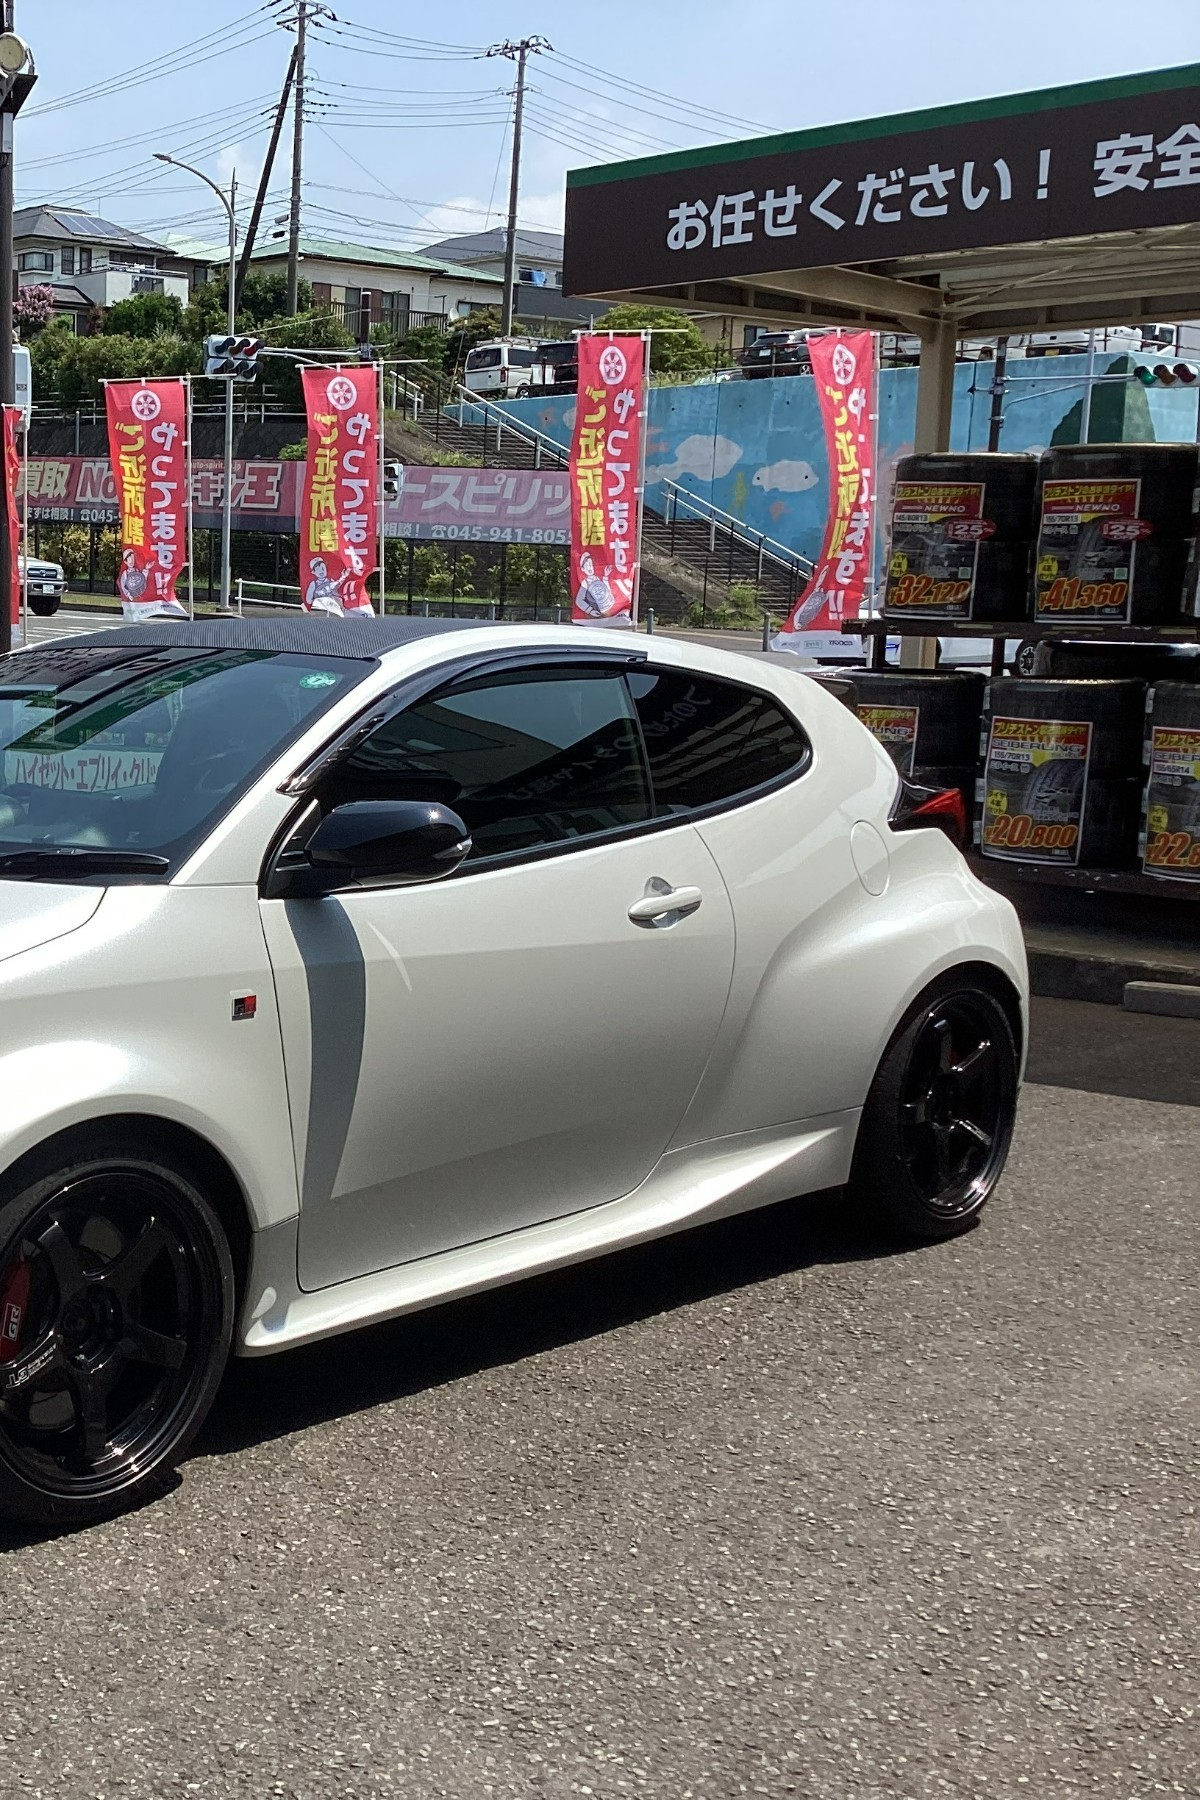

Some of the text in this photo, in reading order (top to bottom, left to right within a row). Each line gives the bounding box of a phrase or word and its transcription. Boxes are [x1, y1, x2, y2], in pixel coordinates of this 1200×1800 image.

[667, 123, 1200, 251] お任せください！ 安全
[924, 505, 966, 513] NEWNO
[1075, 504, 1120, 512] NEWNO
[992, 739, 1085, 753] SEIBERLING
[7, 1305, 20, 1339] GR
